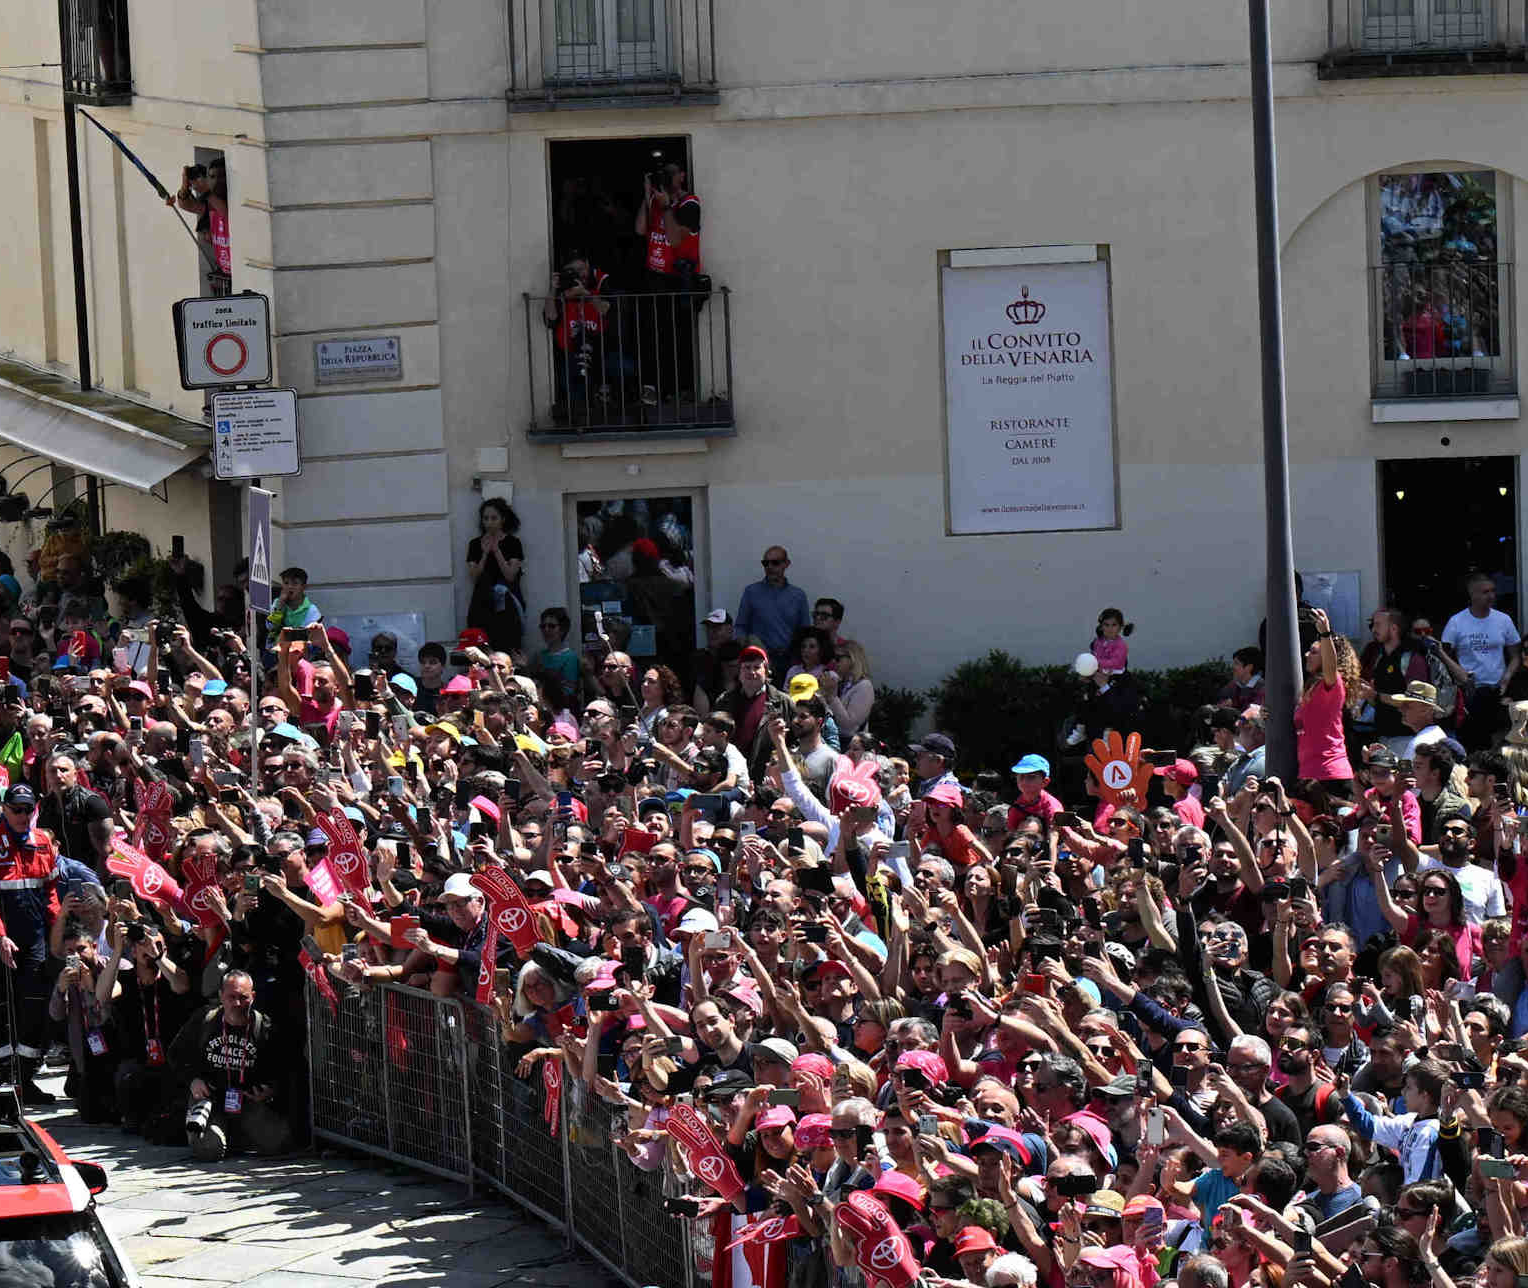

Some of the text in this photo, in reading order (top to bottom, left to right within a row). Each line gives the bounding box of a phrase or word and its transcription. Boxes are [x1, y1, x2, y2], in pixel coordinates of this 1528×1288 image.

[192, 319, 257, 329] traffico limitato
[988, 331, 1081, 350] CONVITO
[344, 346, 373, 354] PIAZZA
[345, 353, 397, 364] REPUBBLICA
[961, 350, 1094, 367] DELLA VENARIA
[982, 373, 1075, 386] La Reggia nel Piatto
[990, 417, 1071, 431] RISTORANTE
[1004, 437, 1057, 450] CAMERE
[1011, 456, 1029, 466] DAL
